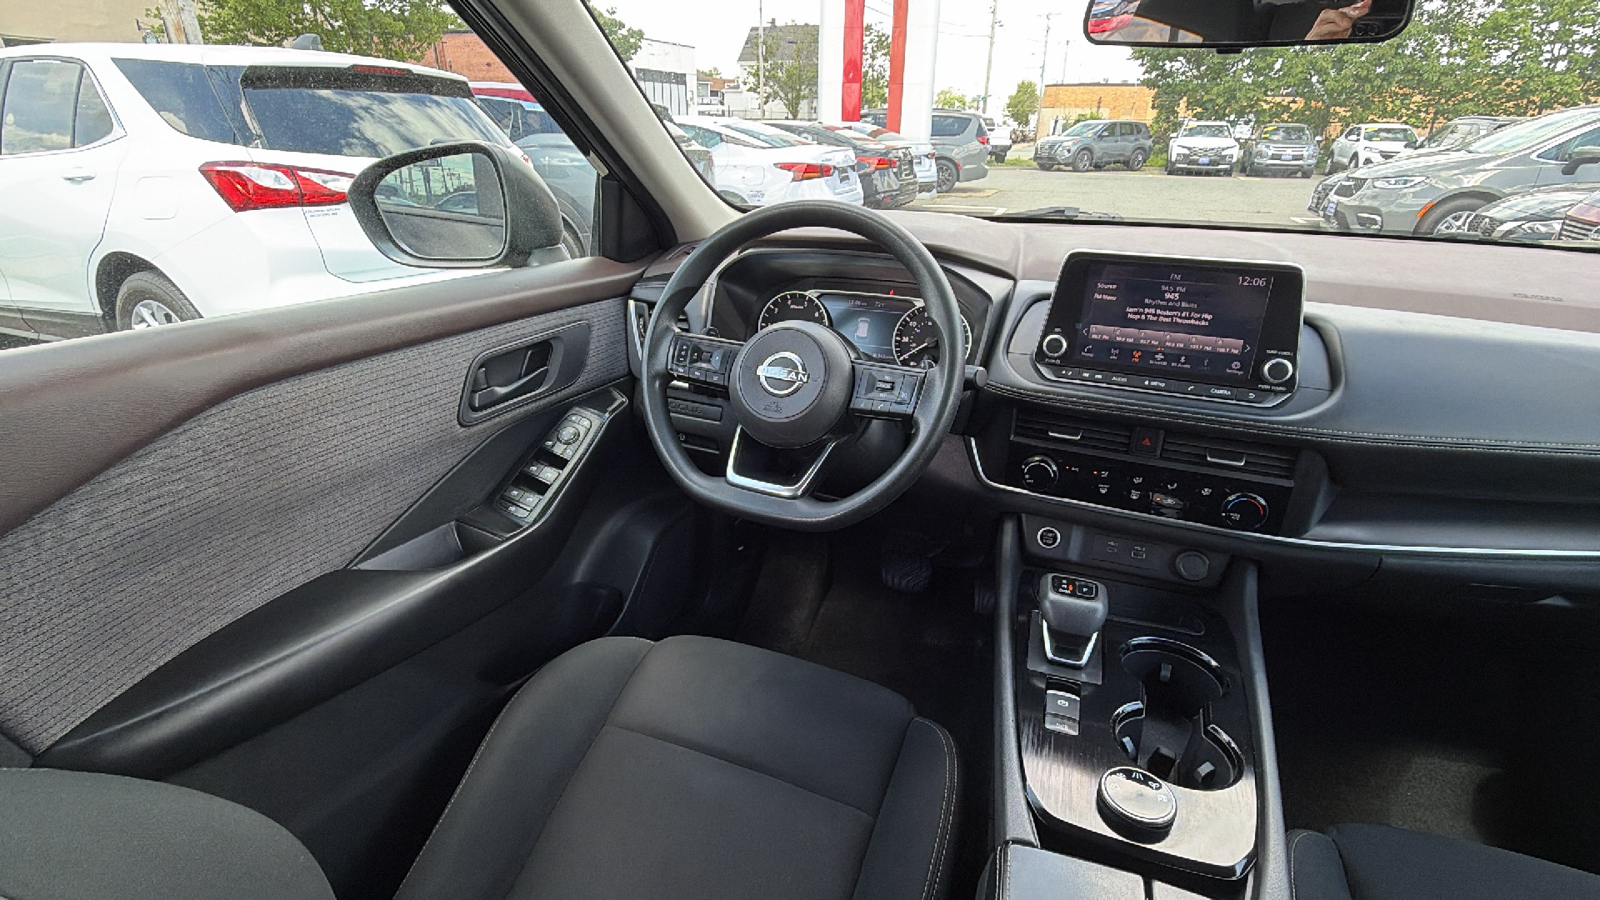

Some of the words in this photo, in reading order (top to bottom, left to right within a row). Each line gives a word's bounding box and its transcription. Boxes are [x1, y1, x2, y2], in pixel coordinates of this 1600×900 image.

[1238, 276, 1267, 287] 12:06
[1164, 292, 1180, 300] 945
[1144, 298, 1168, 306] Rhythm
[1172, 316, 1209, 326] Throwbacks
[760, 366, 808, 383] NISSAN
